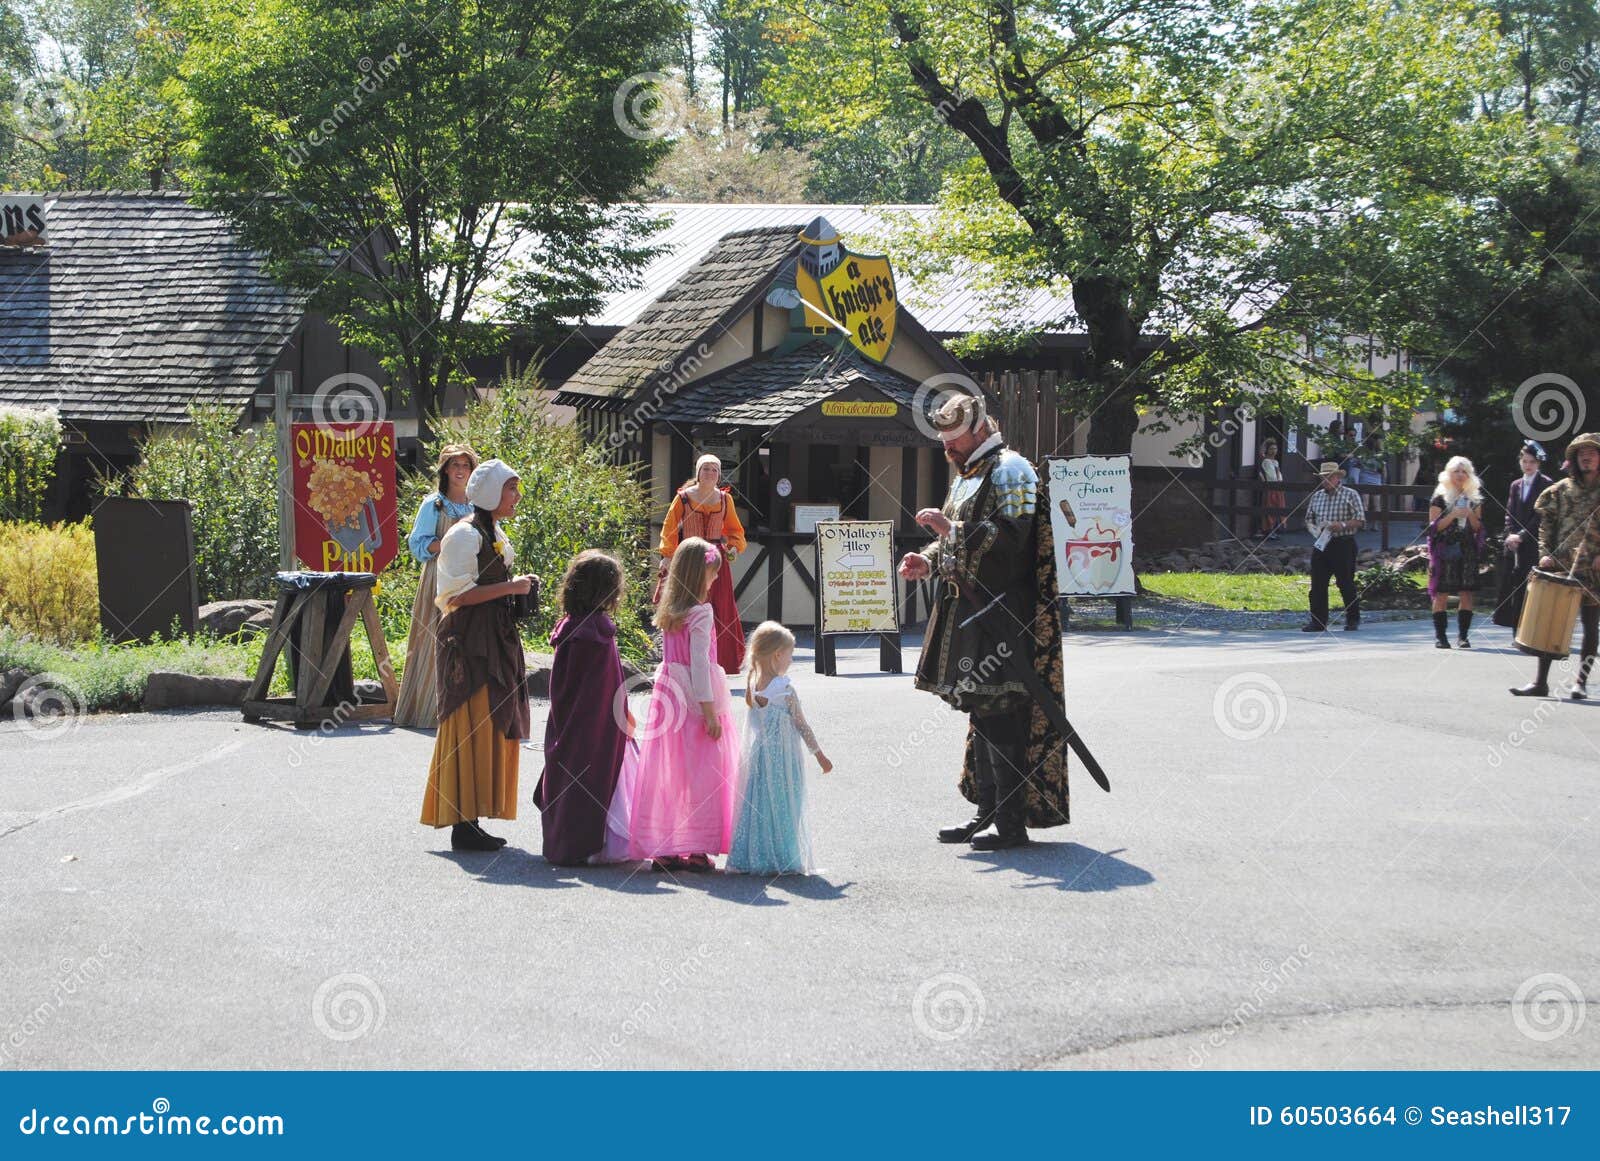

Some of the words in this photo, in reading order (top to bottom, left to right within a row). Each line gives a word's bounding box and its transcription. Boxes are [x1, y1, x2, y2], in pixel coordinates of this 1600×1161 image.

[0, 203, 45, 235] ns
[846, 261, 861, 280] a
[858, 316, 886, 346] ale
[296, 428, 391, 464] O'Malley's
[1083, 464, 1126, 480] Cream
[1069, 482, 1114, 498] Float
[825, 528, 886, 541] O'Malley's
[322, 540, 375, 573] Pub
[842, 541, 871, 553] Alley
